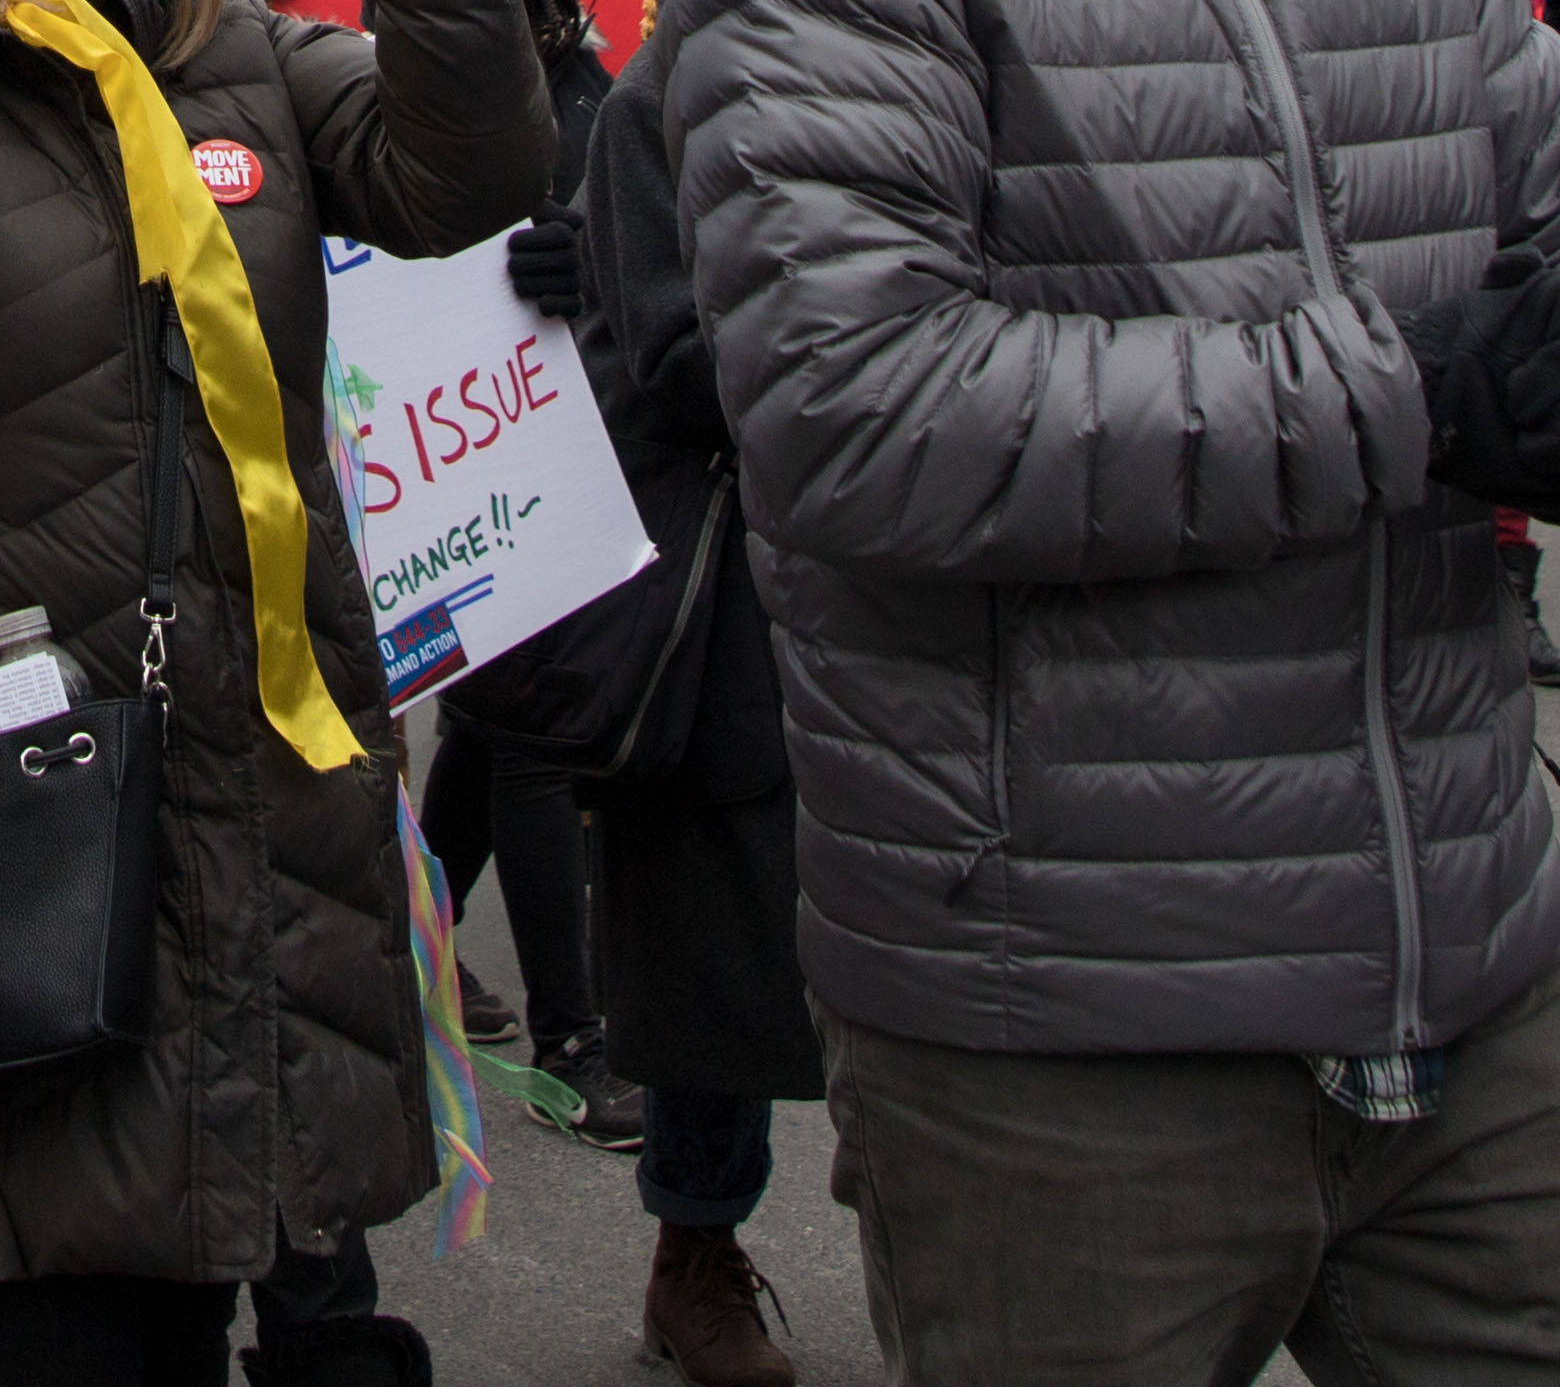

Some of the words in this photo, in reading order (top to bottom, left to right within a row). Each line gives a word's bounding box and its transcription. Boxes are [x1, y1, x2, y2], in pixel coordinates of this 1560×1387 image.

[193, 149, 251, 167] MOVE
[197, 166, 251, 186] MENT
[404, 335, 558, 483] ISSUE
[419, 629, 457, 664] ACTION
